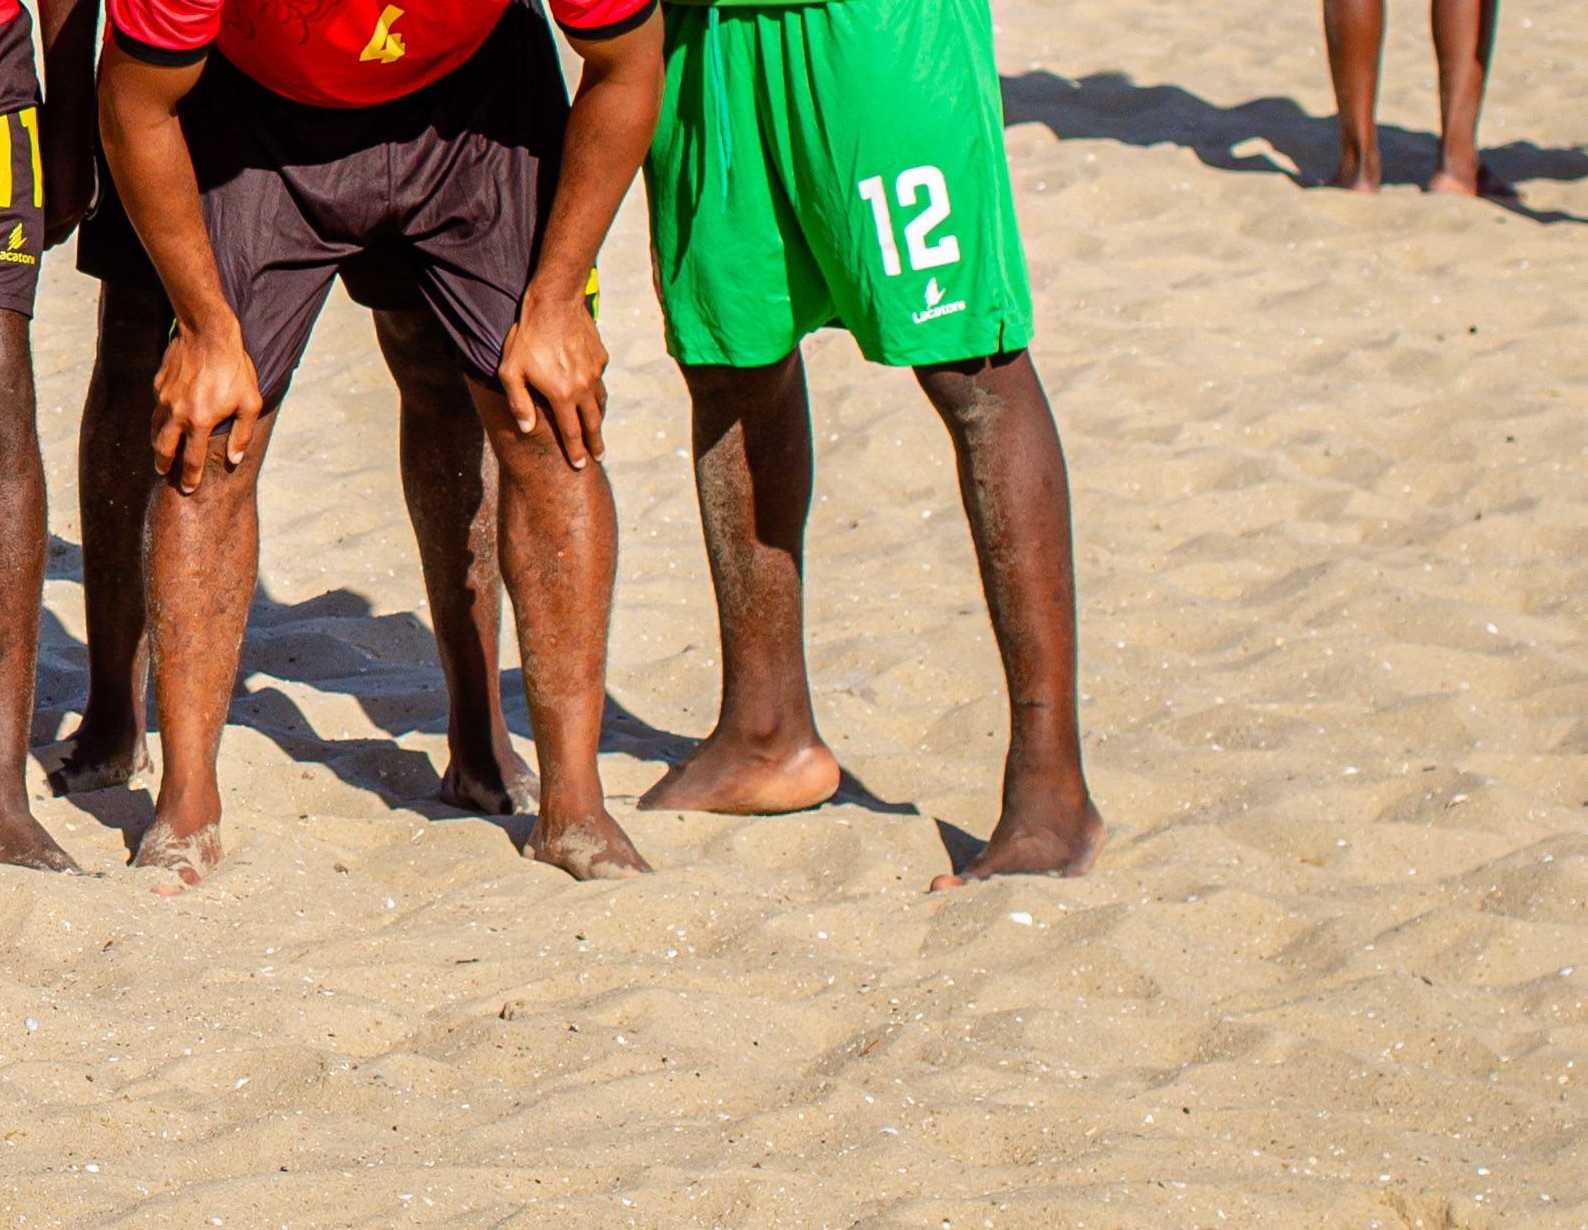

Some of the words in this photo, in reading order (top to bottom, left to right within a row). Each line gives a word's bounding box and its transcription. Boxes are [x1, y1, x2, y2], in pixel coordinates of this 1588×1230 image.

[359, 4, 406, 64] 4
[858, 165, 960, 276] 12
[912, 299, 966, 324] Lacatoni
